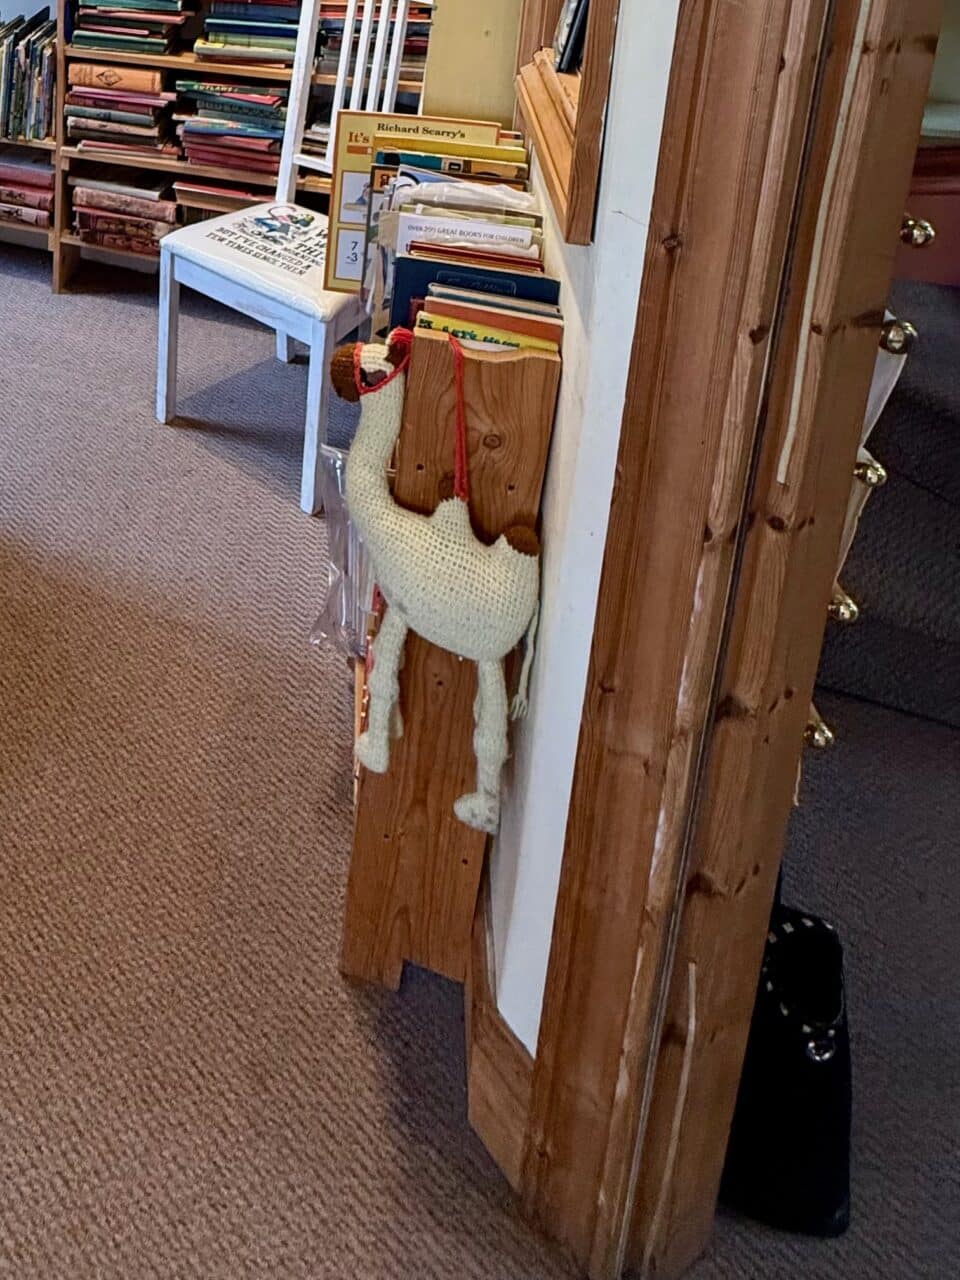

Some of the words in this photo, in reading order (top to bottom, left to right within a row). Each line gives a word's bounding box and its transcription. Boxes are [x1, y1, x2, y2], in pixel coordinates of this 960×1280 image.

[348, 131, 370, 144] It's
[377, 122, 419, 135] Richard
[422, 126, 466, 139] Scarry's
[437, 227, 457, 235] GREAT
[459, 230, 482, 238] BOOKS
[206, 232, 227, 242] FEW
[226, 240, 254, 256] TIMES
[351, 241, 358, 251] 7
[256, 244, 303, 266] CHANGED
